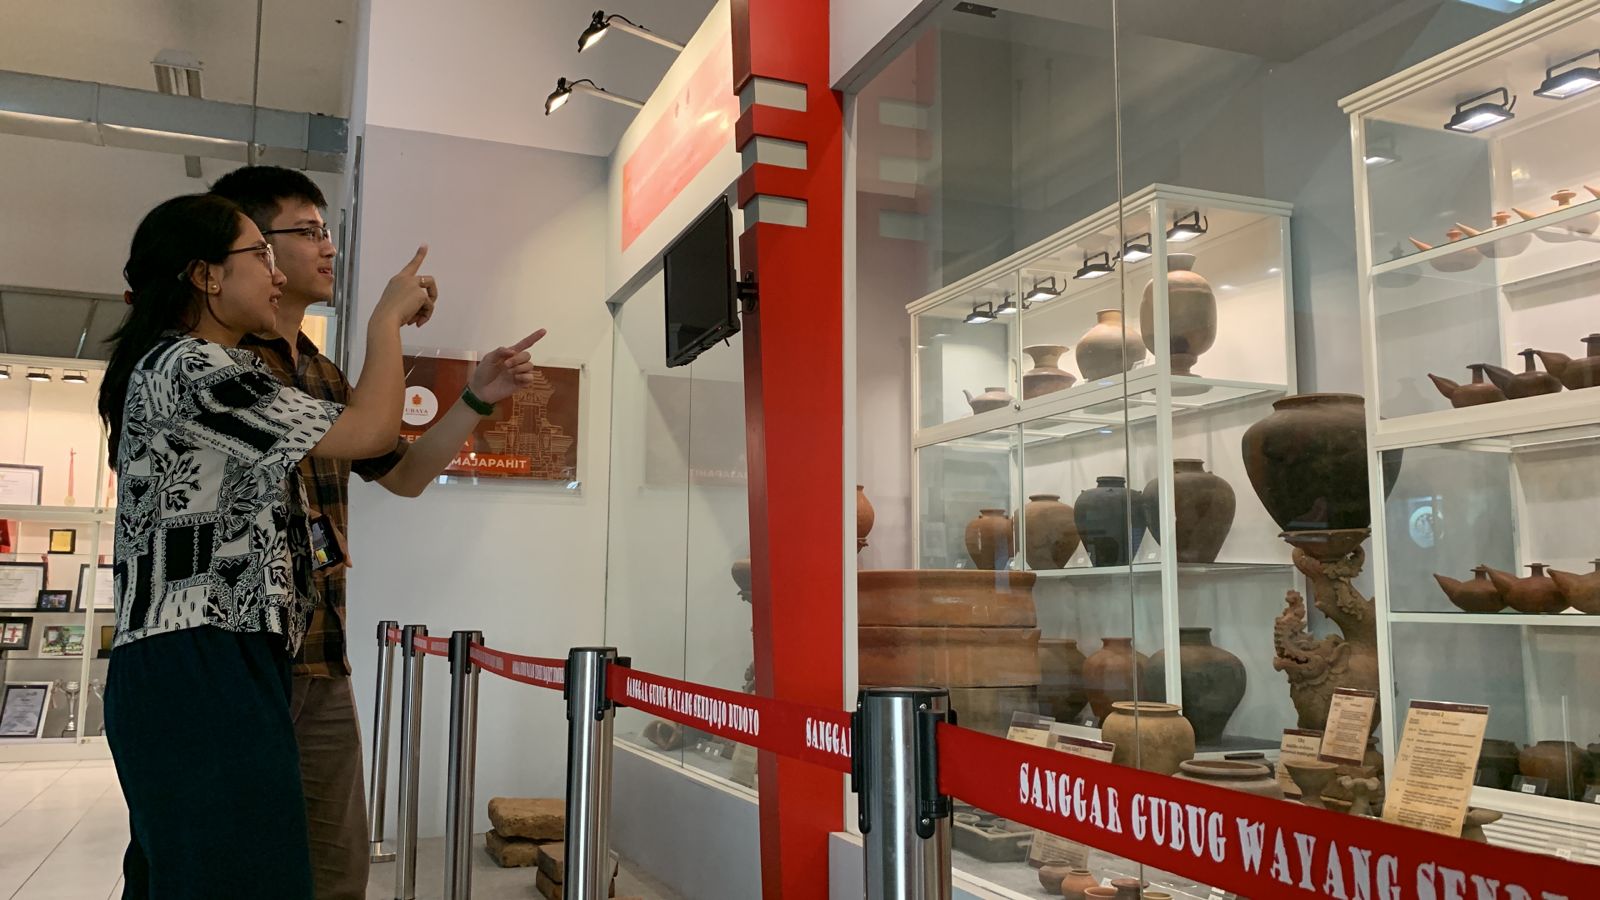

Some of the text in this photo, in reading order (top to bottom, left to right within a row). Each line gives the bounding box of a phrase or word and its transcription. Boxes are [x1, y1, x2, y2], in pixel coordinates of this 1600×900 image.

[452, 457, 527, 469] MAJAPAHIT
[1019, 762, 1123, 834] SANGGAR
[1131, 793, 1227, 863] GUBUG
[1235, 816, 1401, 900] WAYANG
